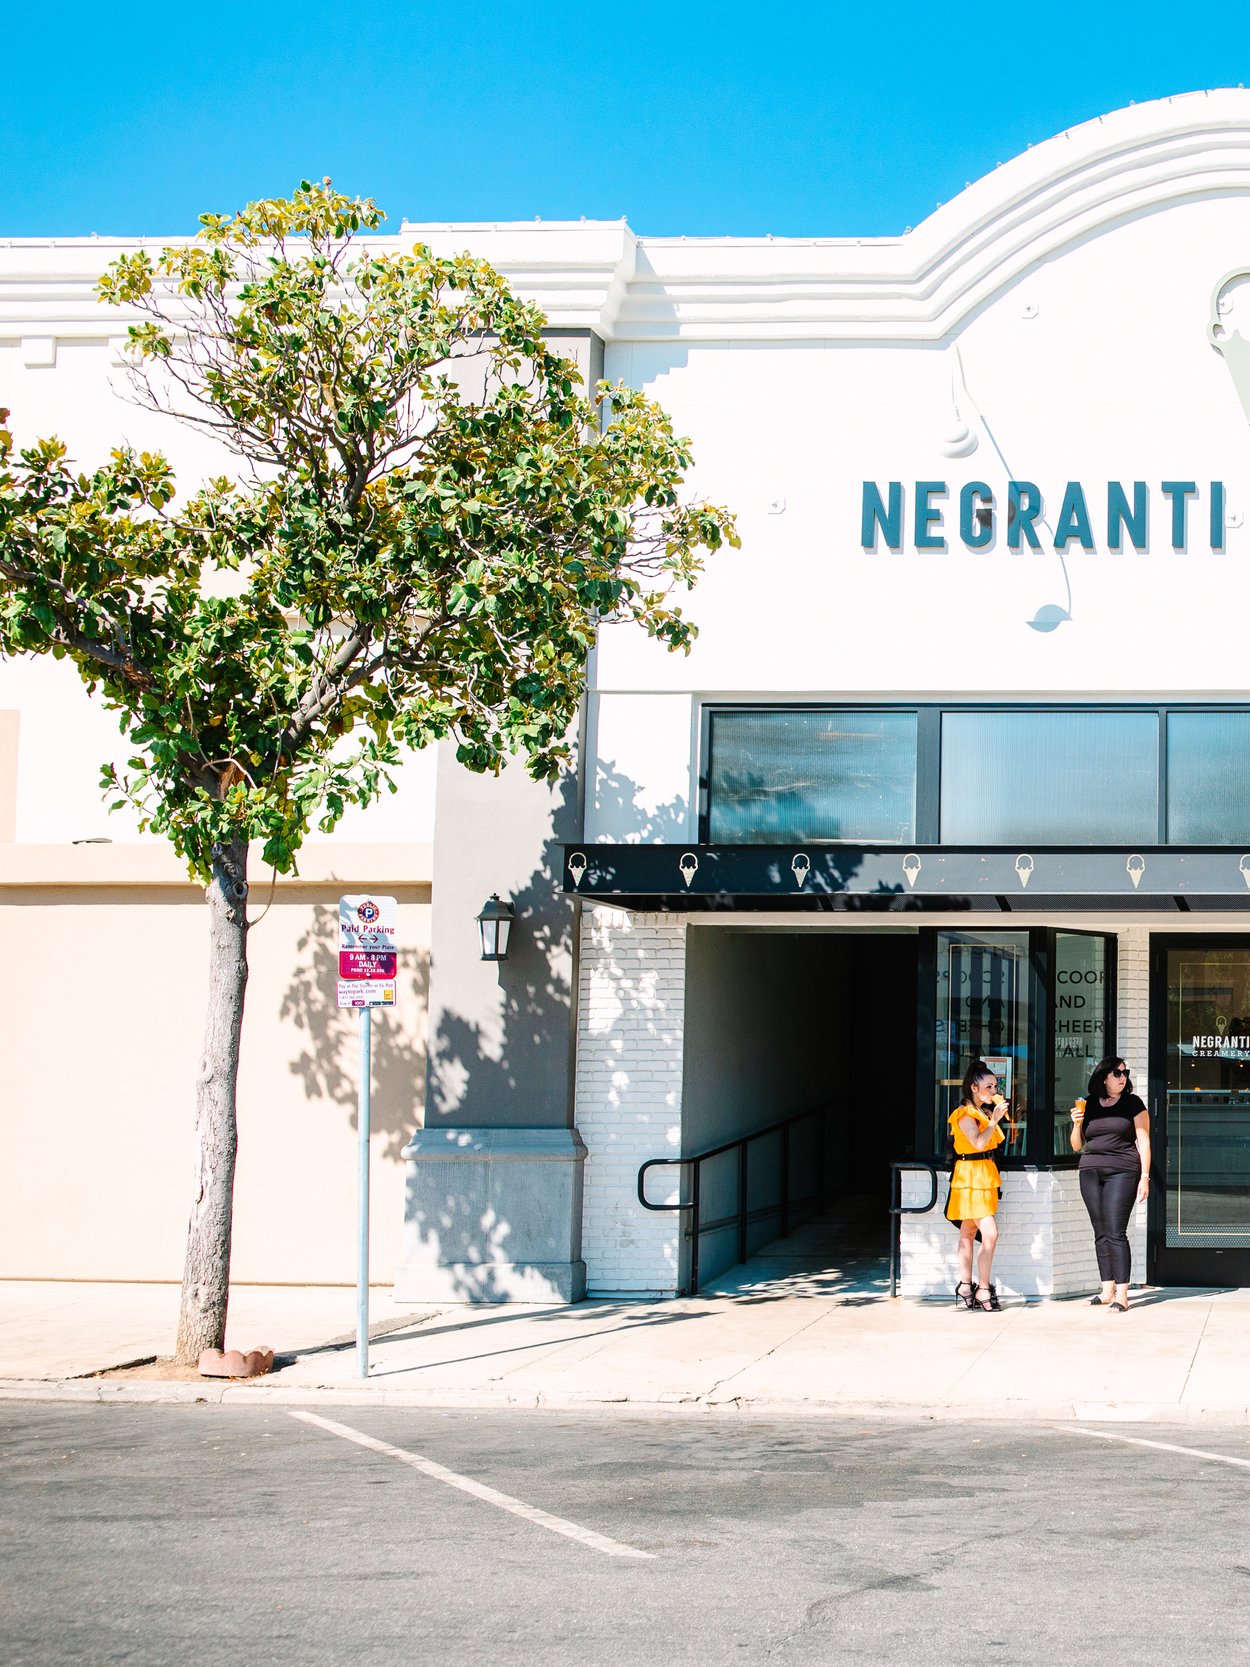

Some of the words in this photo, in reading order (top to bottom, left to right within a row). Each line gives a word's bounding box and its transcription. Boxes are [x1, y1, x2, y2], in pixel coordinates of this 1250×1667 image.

[862, 480, 1224, 549] NEGRANTI
[341, 924, 359, 933] Paid
[363, 925, 395, 935] Parking
[1054, 1020, 1104, 1033] HEER
[1192, 1035, 1250, 1049] NEGRANTI
